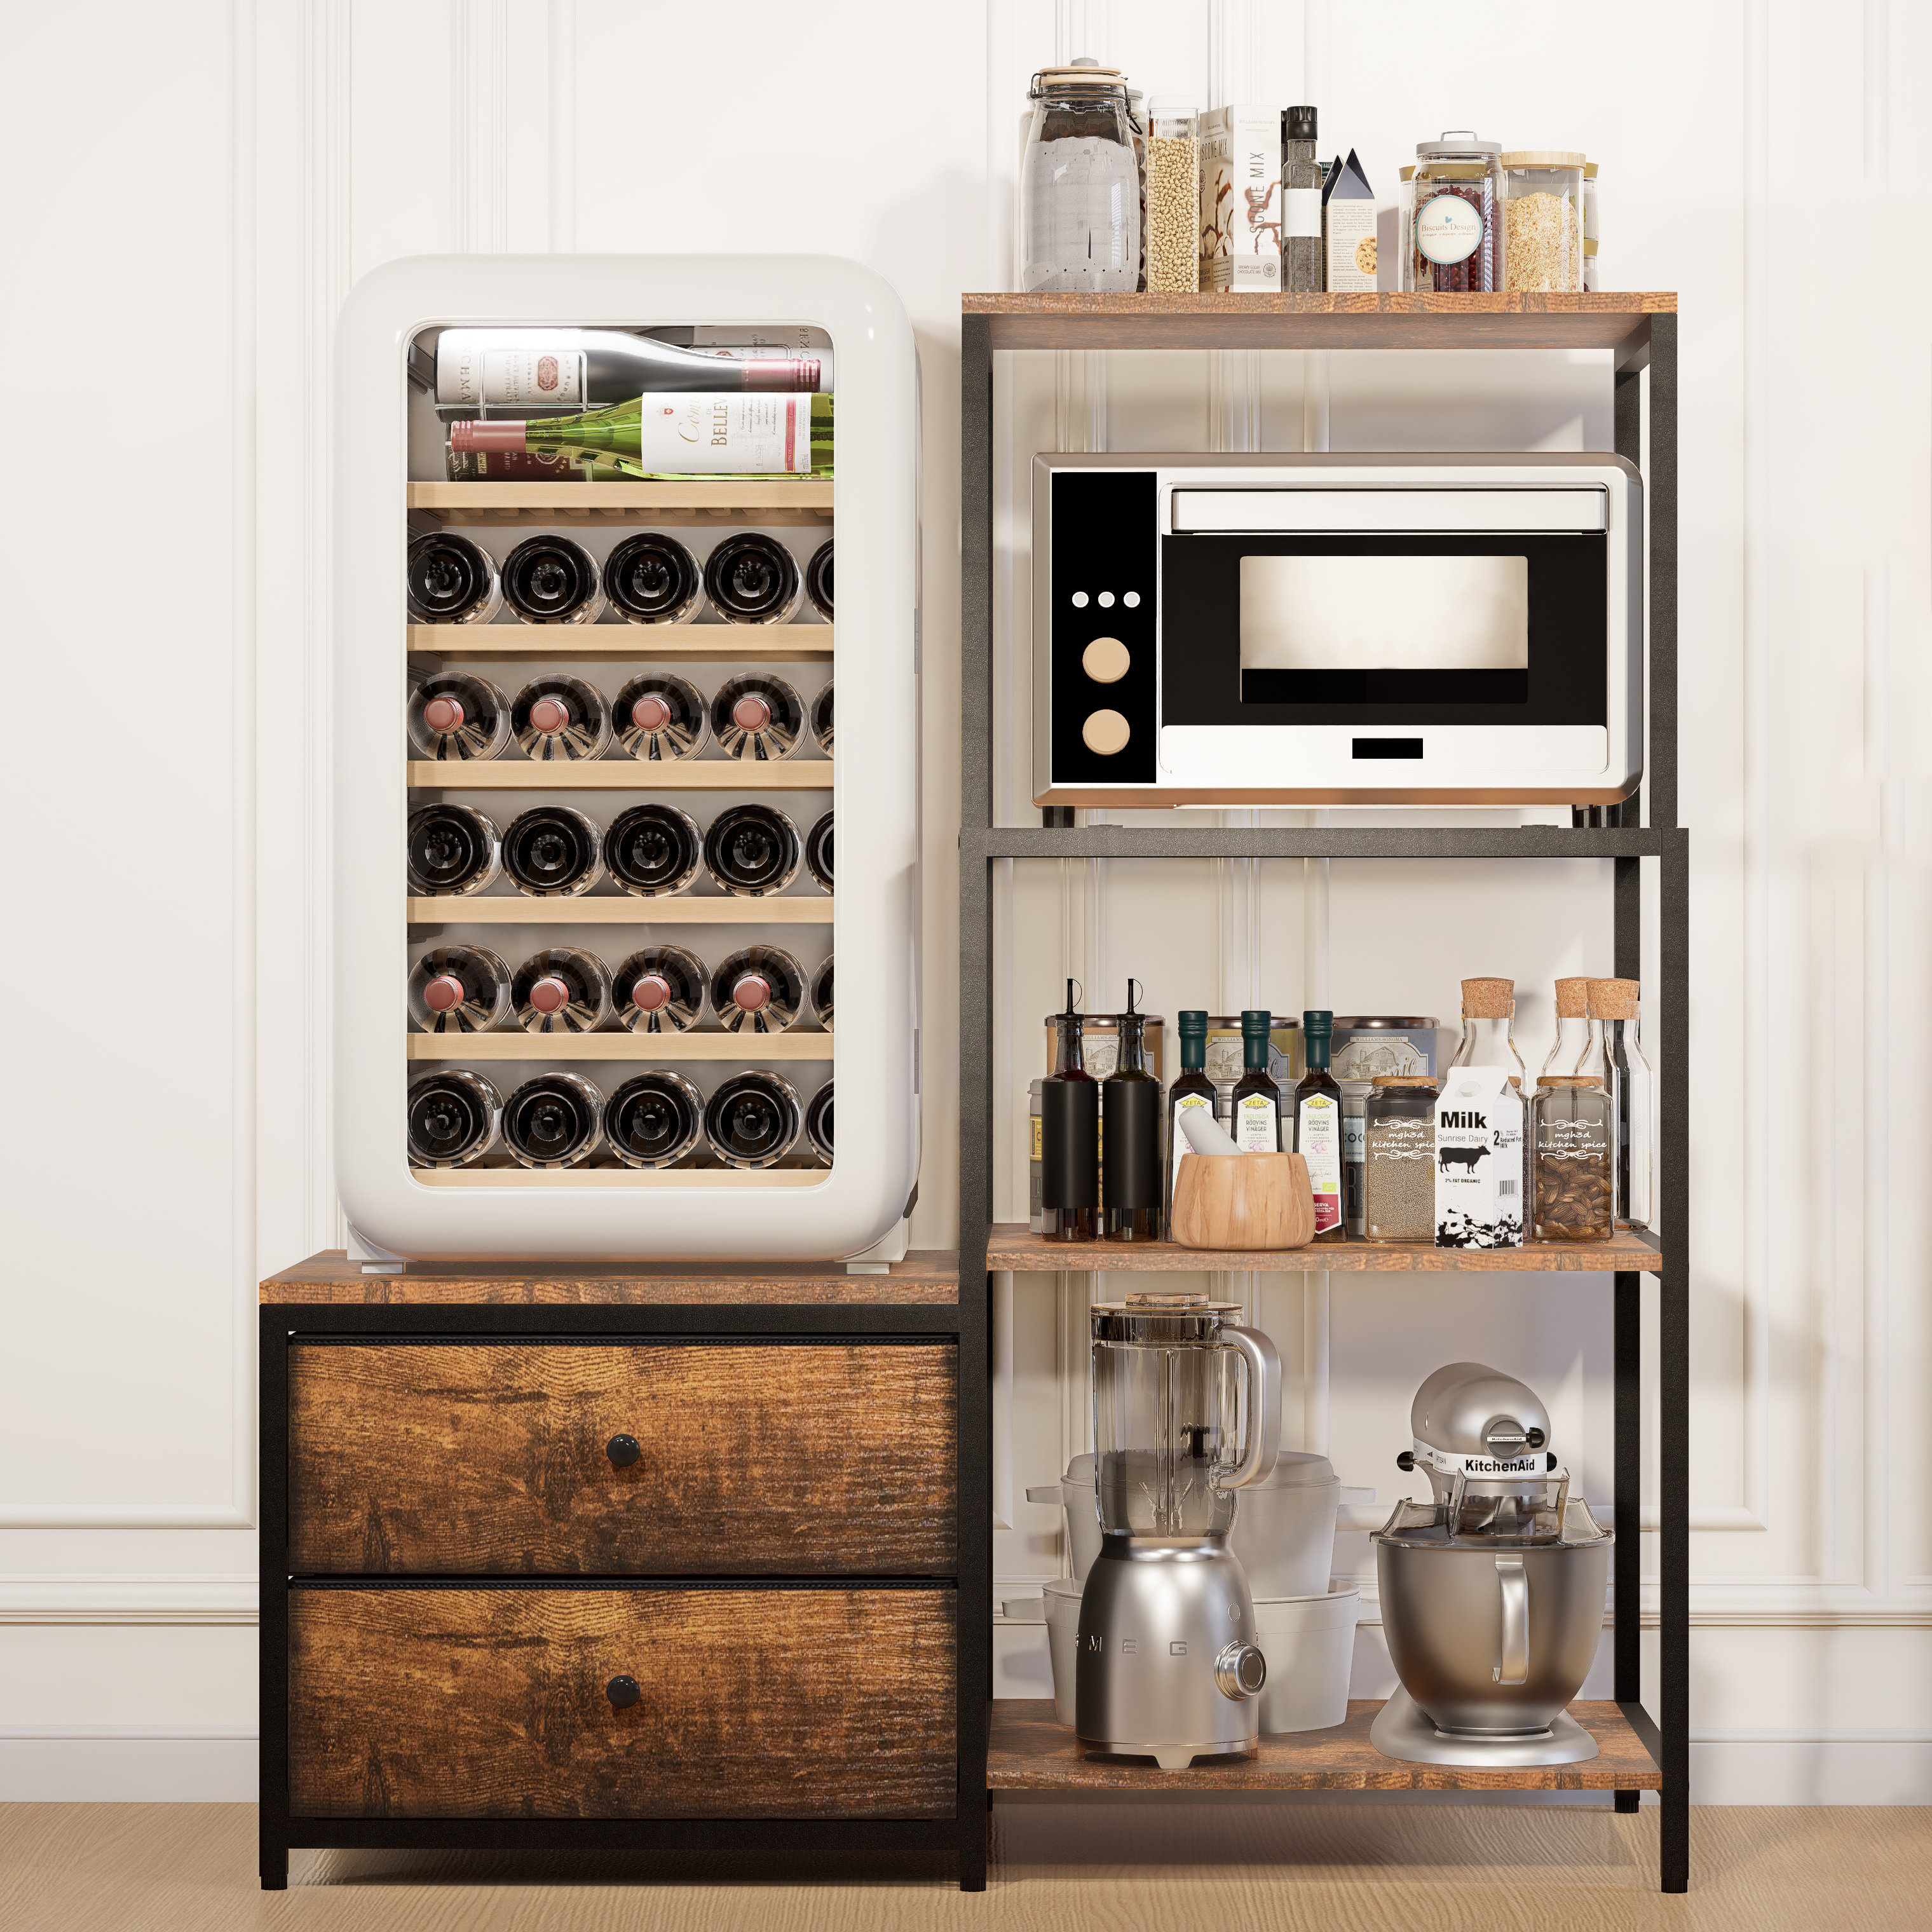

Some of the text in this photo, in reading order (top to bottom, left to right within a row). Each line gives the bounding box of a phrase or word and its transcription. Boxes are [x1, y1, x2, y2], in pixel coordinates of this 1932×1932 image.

[1201, 138, 1228, 161] SCONE MIX
[1249, 153, 1265, 233] SCONE MIX
[1422, 223, 1476, 232] Biscuits Design
[711, 395, 728, 446] BELLEV
[1441, 1111, 1488, 1129] Milk
[1388, 1131, 1425, 1139] mgh3d
[1438, 1134, 1488, 1145] Sunrise Dairy
[1554, 1131, 1591, 1139] mgh3d
[1415, 1141, 1435, 1149] spic
[1581, 1141, 1607, 1150] spice
[1466, 1459, 1535, 1472] KitchenAid
